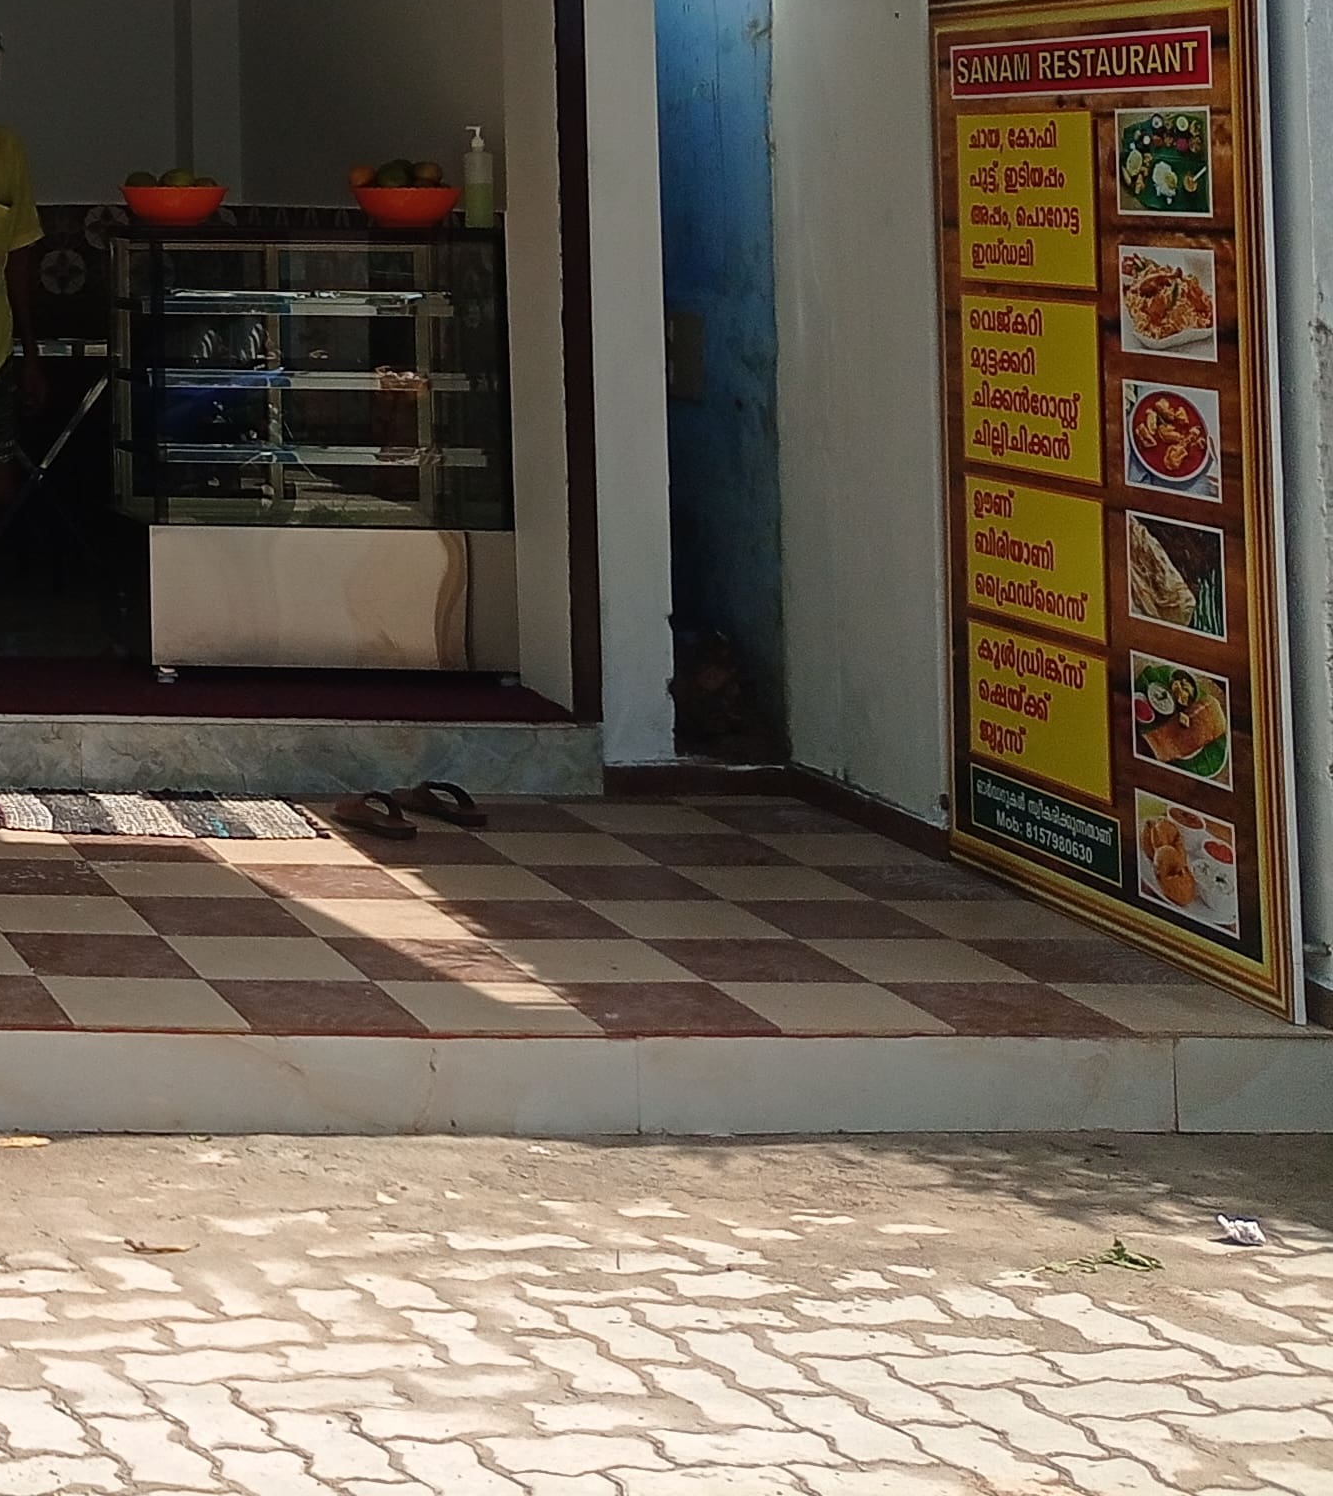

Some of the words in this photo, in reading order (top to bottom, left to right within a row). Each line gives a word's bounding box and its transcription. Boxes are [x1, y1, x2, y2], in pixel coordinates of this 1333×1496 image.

[956, 52, 1030, 84] SANAM
[1038, 41, 1199, 80] RESTAURANT
[1008, 120, 1057, 149] കോഫി
[1016, 206, 1080, 234] പൊറോട്ട
[975, 527, 1054, 571] ബിരിയാണി
[996, 809, 1023, 835] Mob:
[1026, 822, 1093, 864] 8157980630
